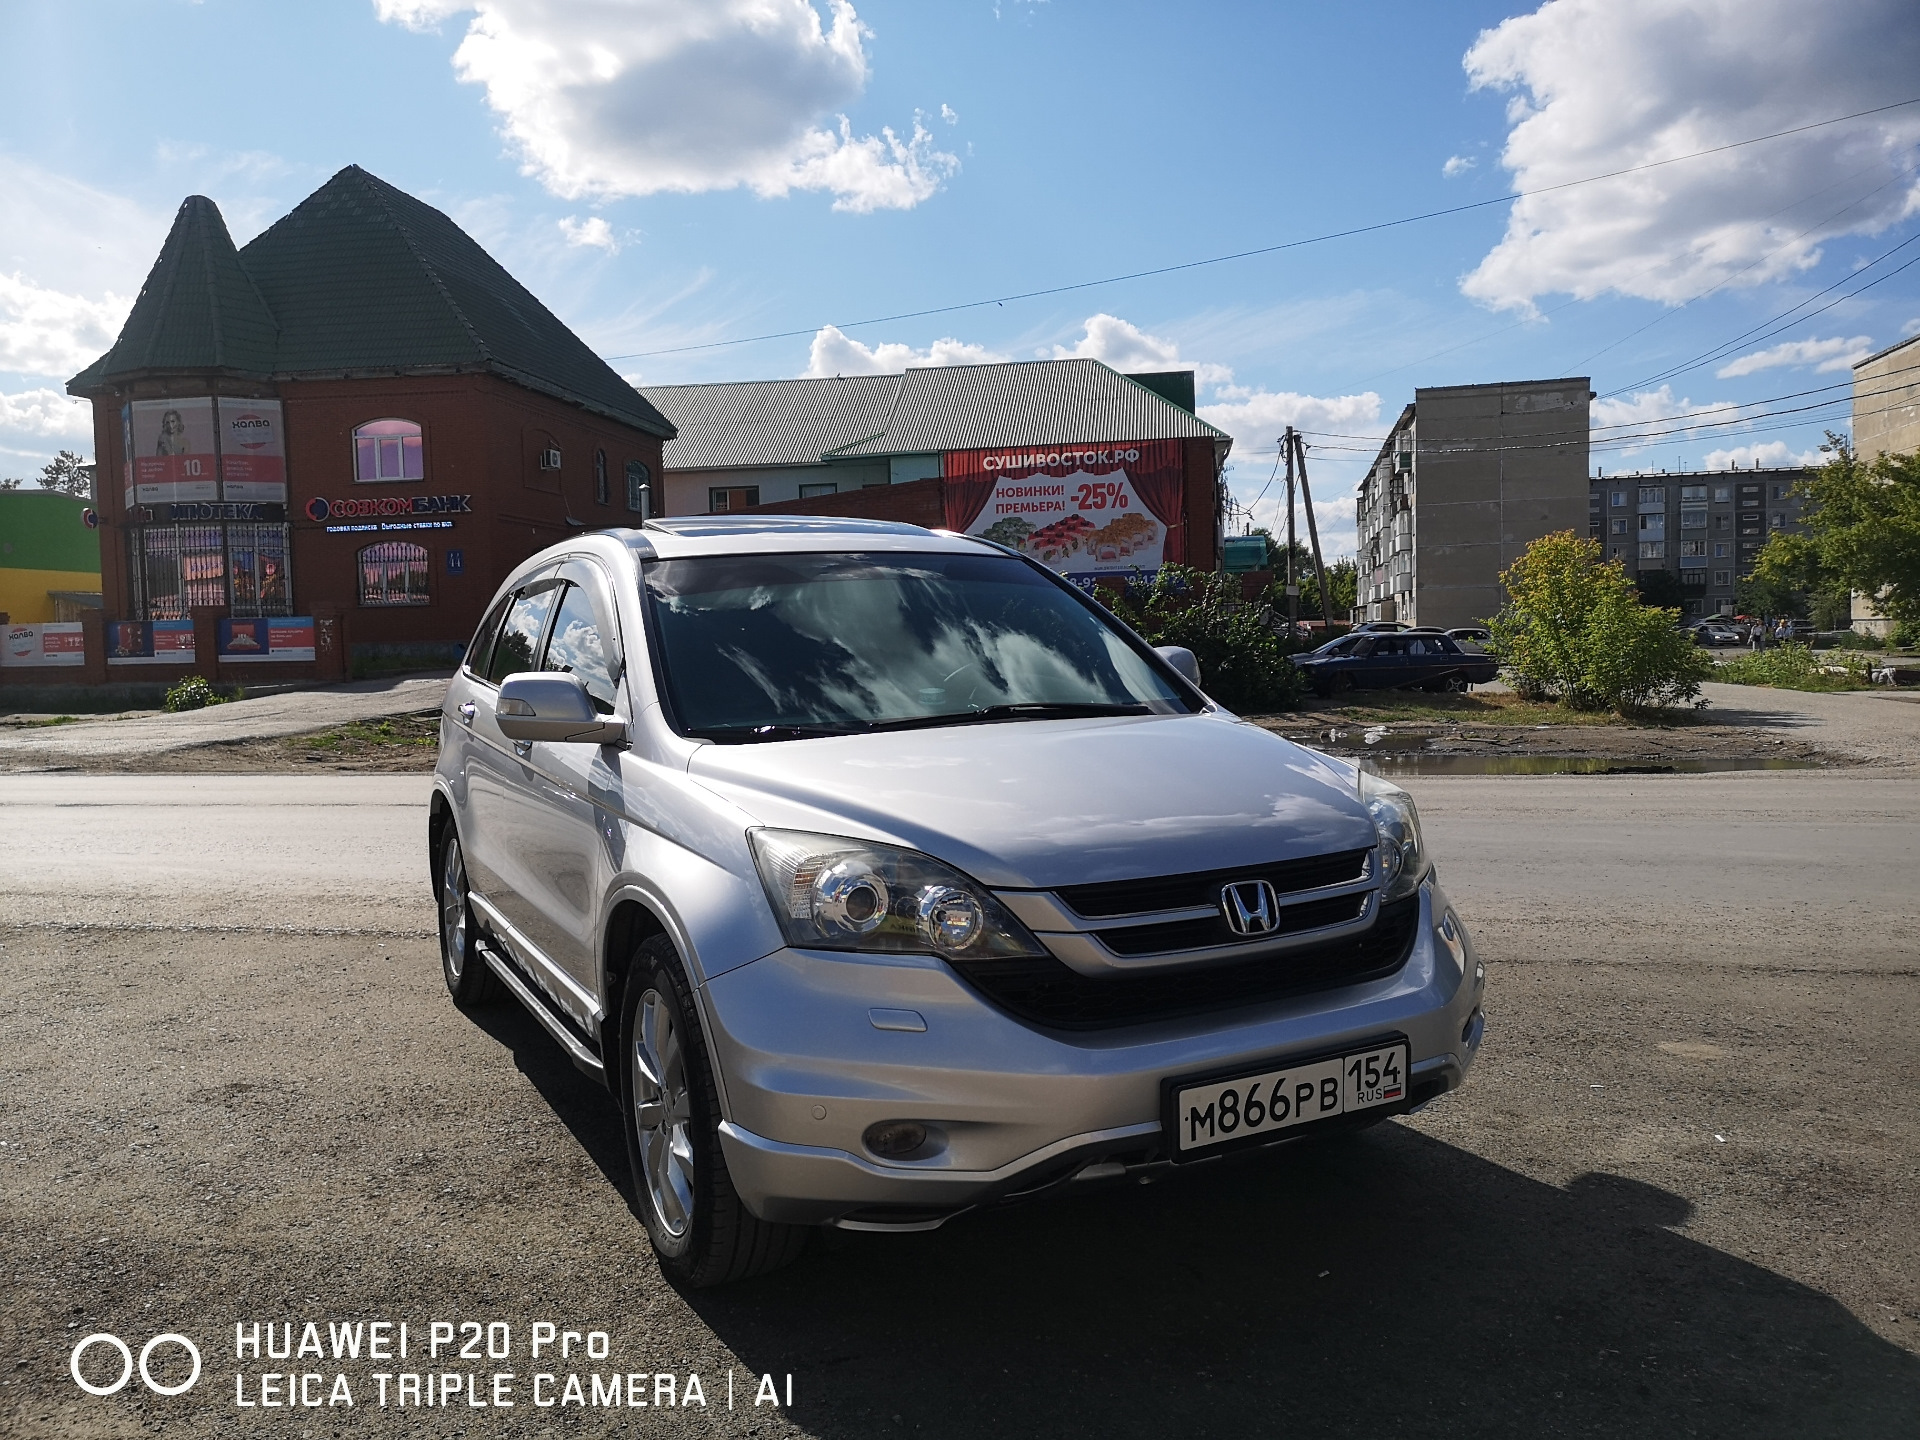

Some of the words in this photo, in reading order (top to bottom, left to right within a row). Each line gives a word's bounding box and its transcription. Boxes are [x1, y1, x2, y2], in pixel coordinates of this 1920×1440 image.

[183, 459, 201, 476] 10
[982, 448, 1140, 471] СУШИВОСТОК.РФ
[995, 484, 1065, 499] НОВИНКИ!
[1070, 482, 1129, 510] -25%
[170, 502, 266, 521] ИПОТЕКА
[329, 494, 472, 518] СОВКОМБАНК
[995, 500, 1066, 514] ПРЕМЬЕРА!
[1190, 1077, 1339, 1142] М866РВ
[1347, 1052, 1399, 1092] 154
[1357, 1088, 1383, 1105] RUS
